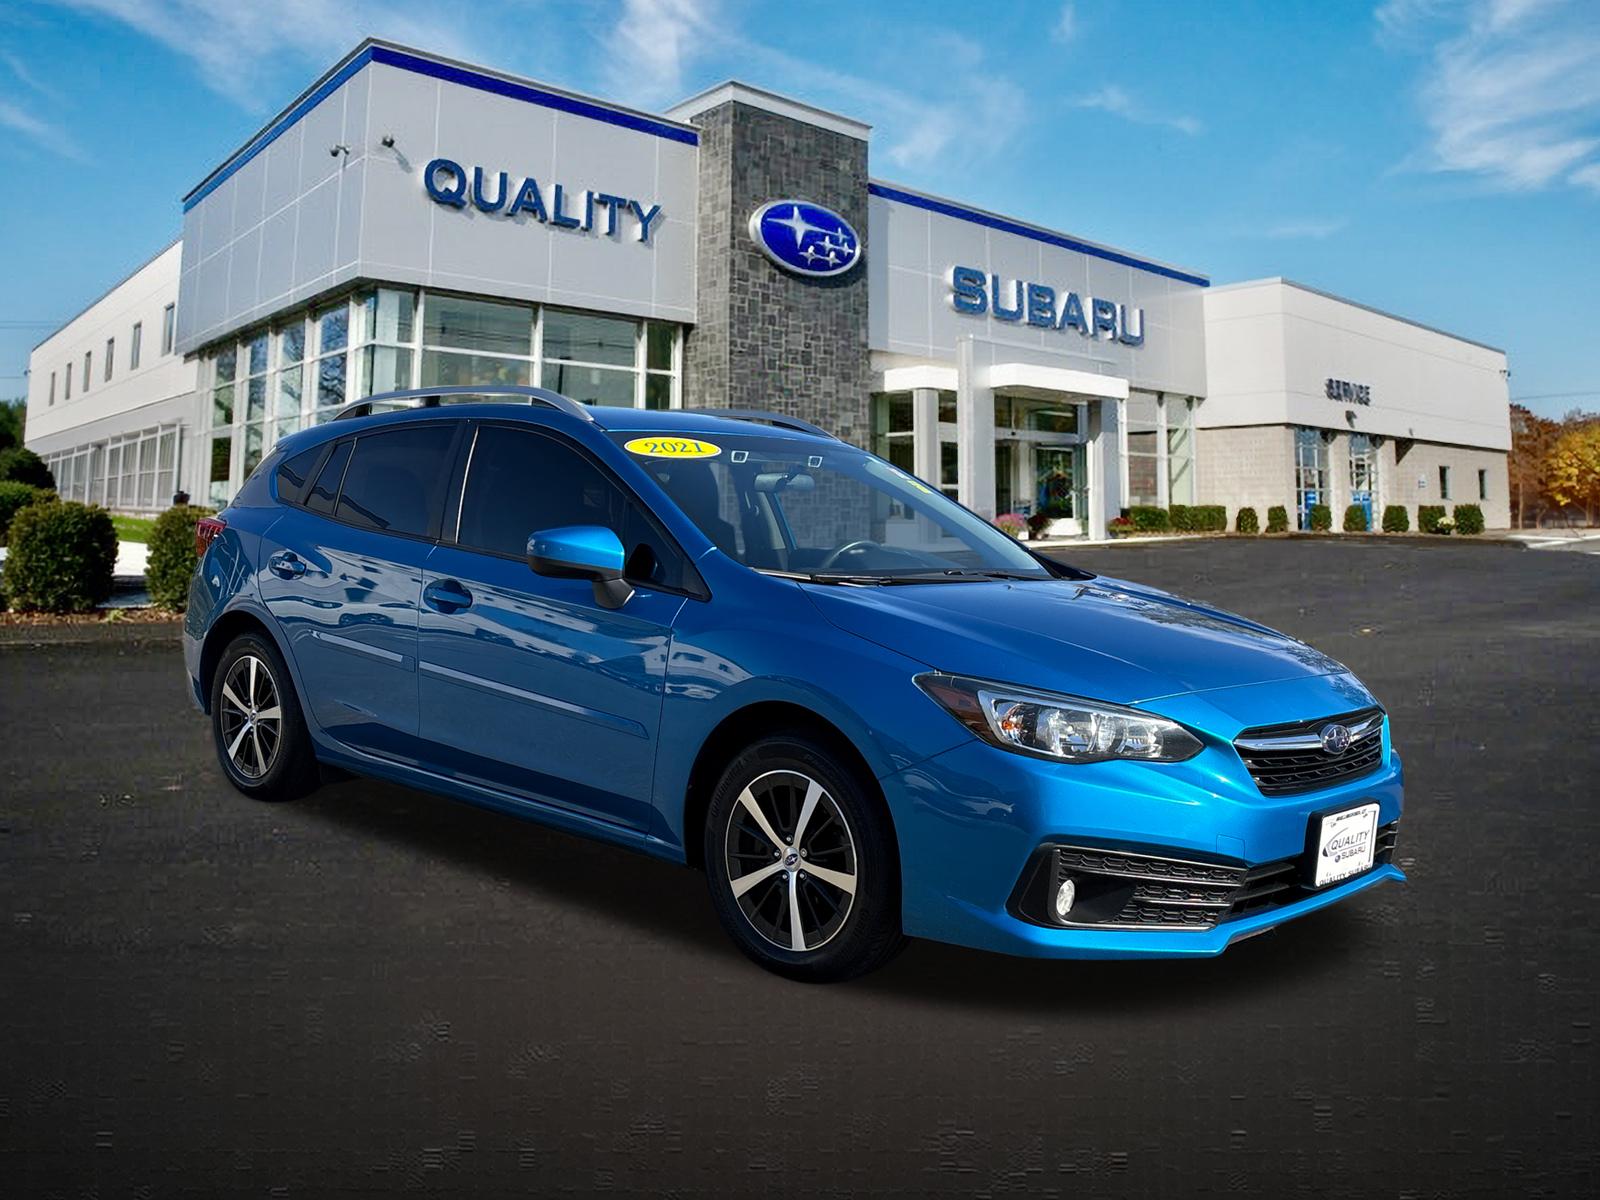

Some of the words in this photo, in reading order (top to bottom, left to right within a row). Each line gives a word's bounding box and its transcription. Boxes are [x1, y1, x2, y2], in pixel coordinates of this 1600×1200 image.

[424, 158, 661, 242] QUALITY
[951, 265, 1144, 346] SUBARU
[1324, 378, 1370, 407] SERVICE
[644, 441, 706, 454] 2021
[1331, 830, 1370, 851] QUALITY
[1341, 845, 1366, 859] SUBARU
